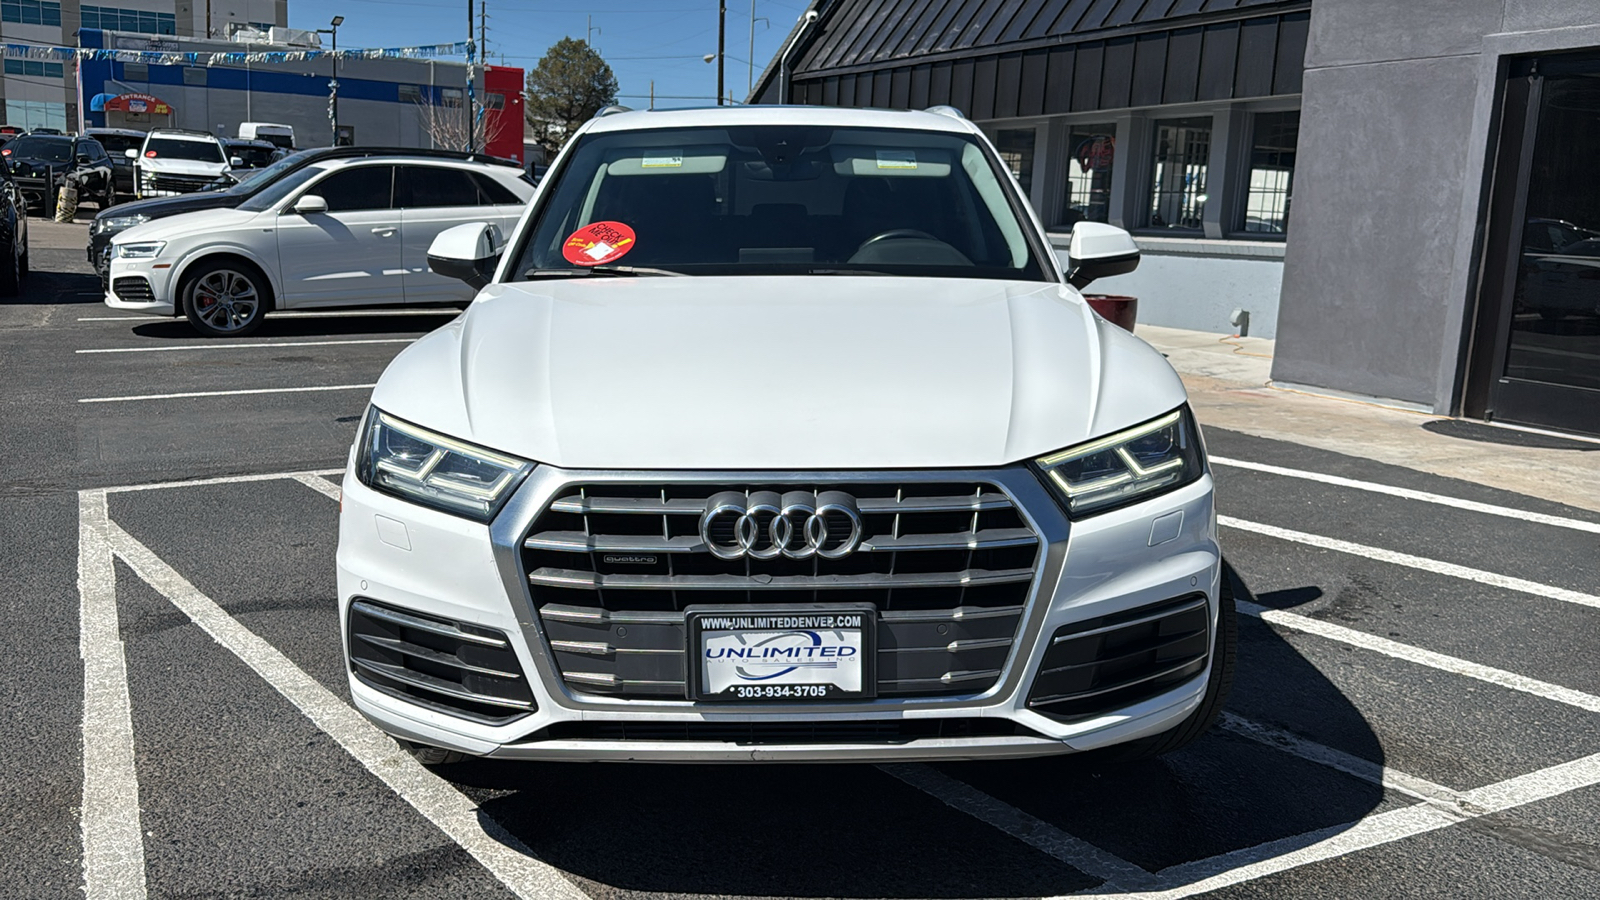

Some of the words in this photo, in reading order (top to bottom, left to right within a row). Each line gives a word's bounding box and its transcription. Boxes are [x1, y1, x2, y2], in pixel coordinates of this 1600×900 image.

[121, 93, 155, 102] ENTRANCE
[588, 227, 601, 237] ME
[597, 223, 625, 240] CHECK
[701, 616, 861, 629] WWWUNLIMITEDDENVER.COM
[705, 646, 857, 659] UNLIMITED
[737, 686, 826, 698] 303-934-3705
